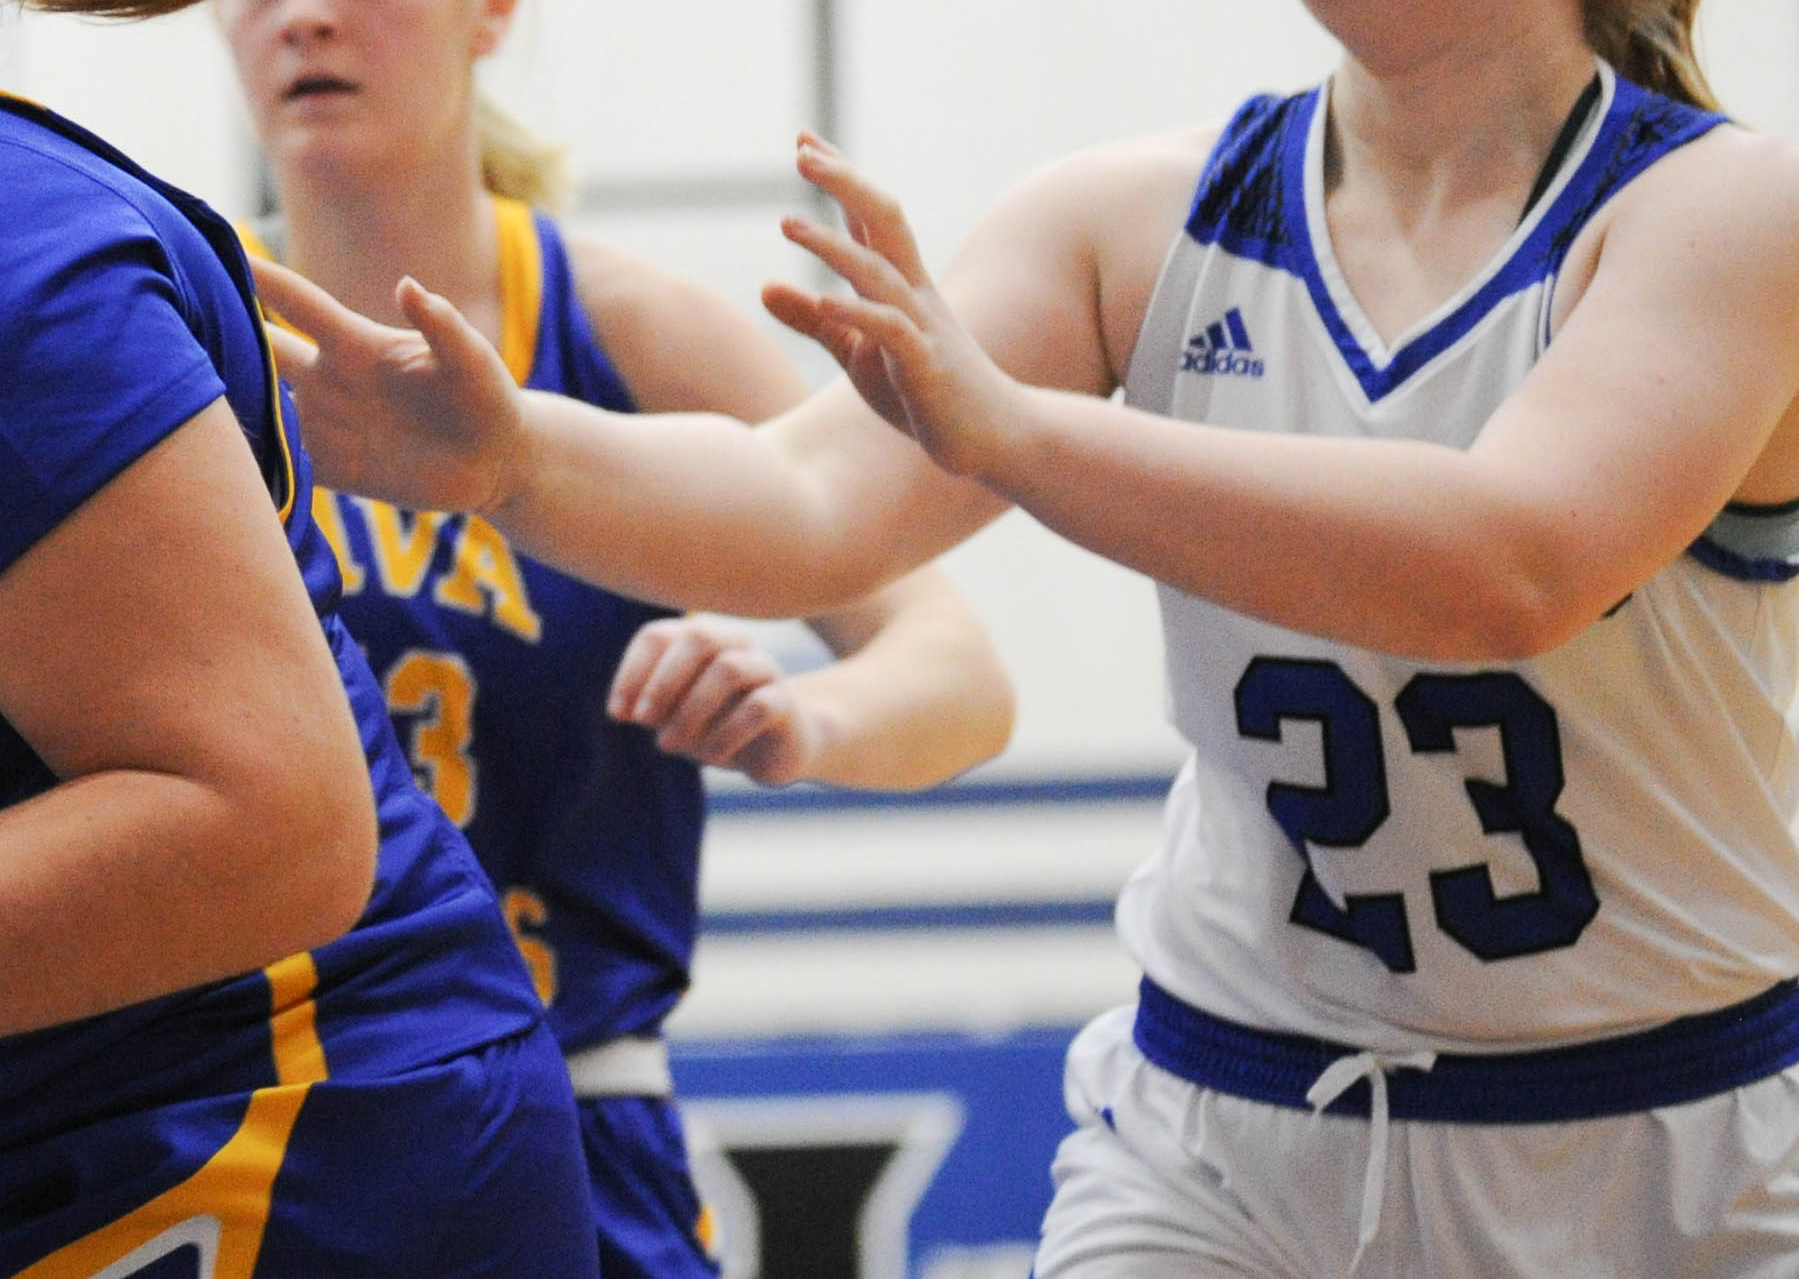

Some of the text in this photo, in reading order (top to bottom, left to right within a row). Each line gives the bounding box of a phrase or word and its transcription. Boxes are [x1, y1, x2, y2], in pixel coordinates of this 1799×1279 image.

[1177, 349, 1265, 378] adidas
[360, 644, 479, 830] 3
[1233, 654, 1601, 973] 23
